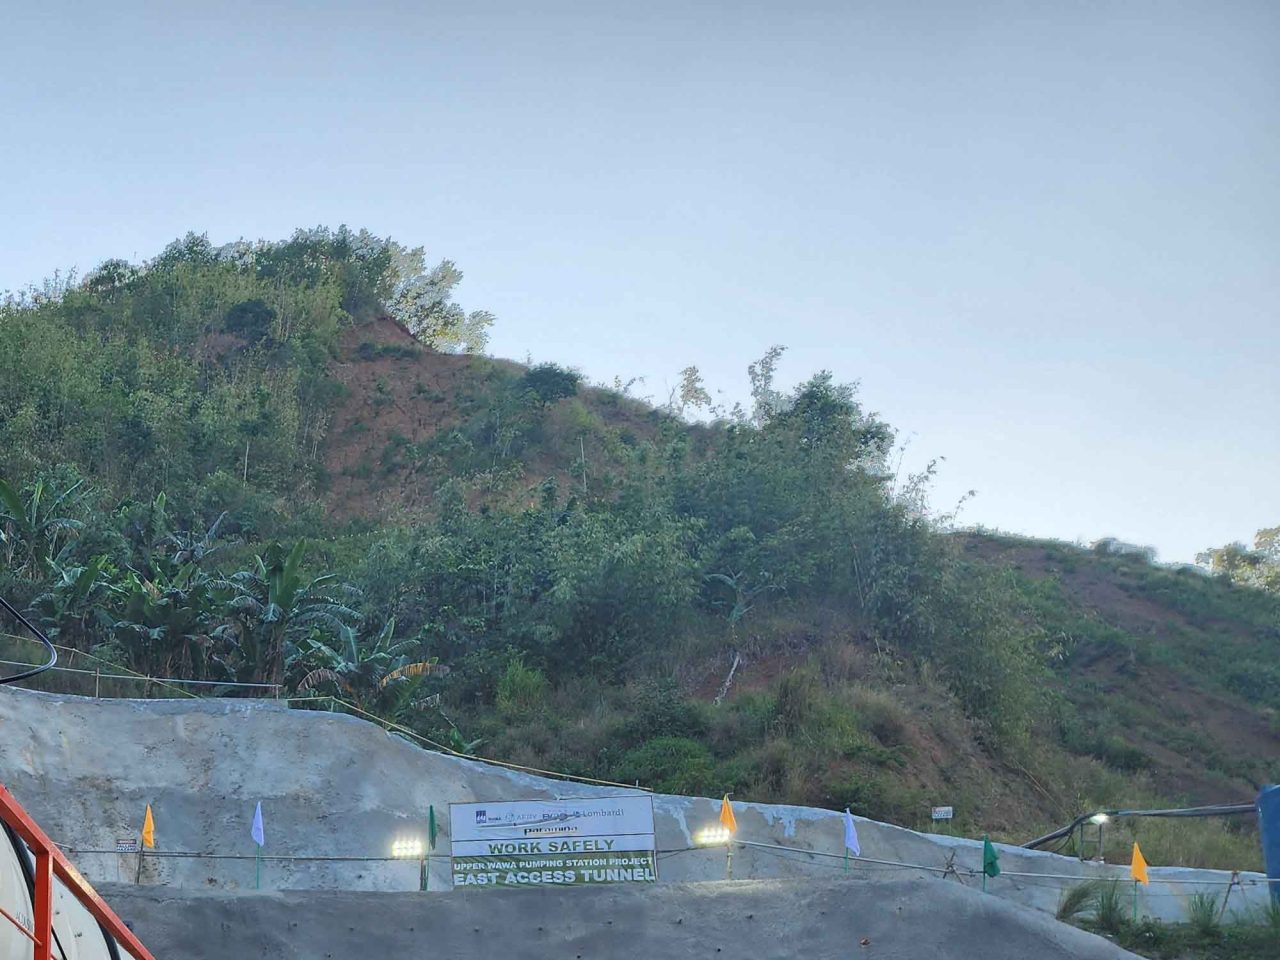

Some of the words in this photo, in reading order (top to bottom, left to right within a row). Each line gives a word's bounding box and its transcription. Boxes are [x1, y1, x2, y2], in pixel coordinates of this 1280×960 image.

[583, 808, 624, 817] Lombardi
[488, 842, 542, 855] WORK
[548, 839, 615, 853] SAFELY
[453, 862, 485, 871] UPPER
[487, 861, 517, 869] WAWA
[519, 859, 564, 868] PUMPING
[565, 858, 607, 867] STATION
[609, 856, 653, 866] PROJECT
[453, 873, 499, 886] EAST
[505, 870, 576, 884] ACCESS
[581, 868, 656, 882] TUNNEL
